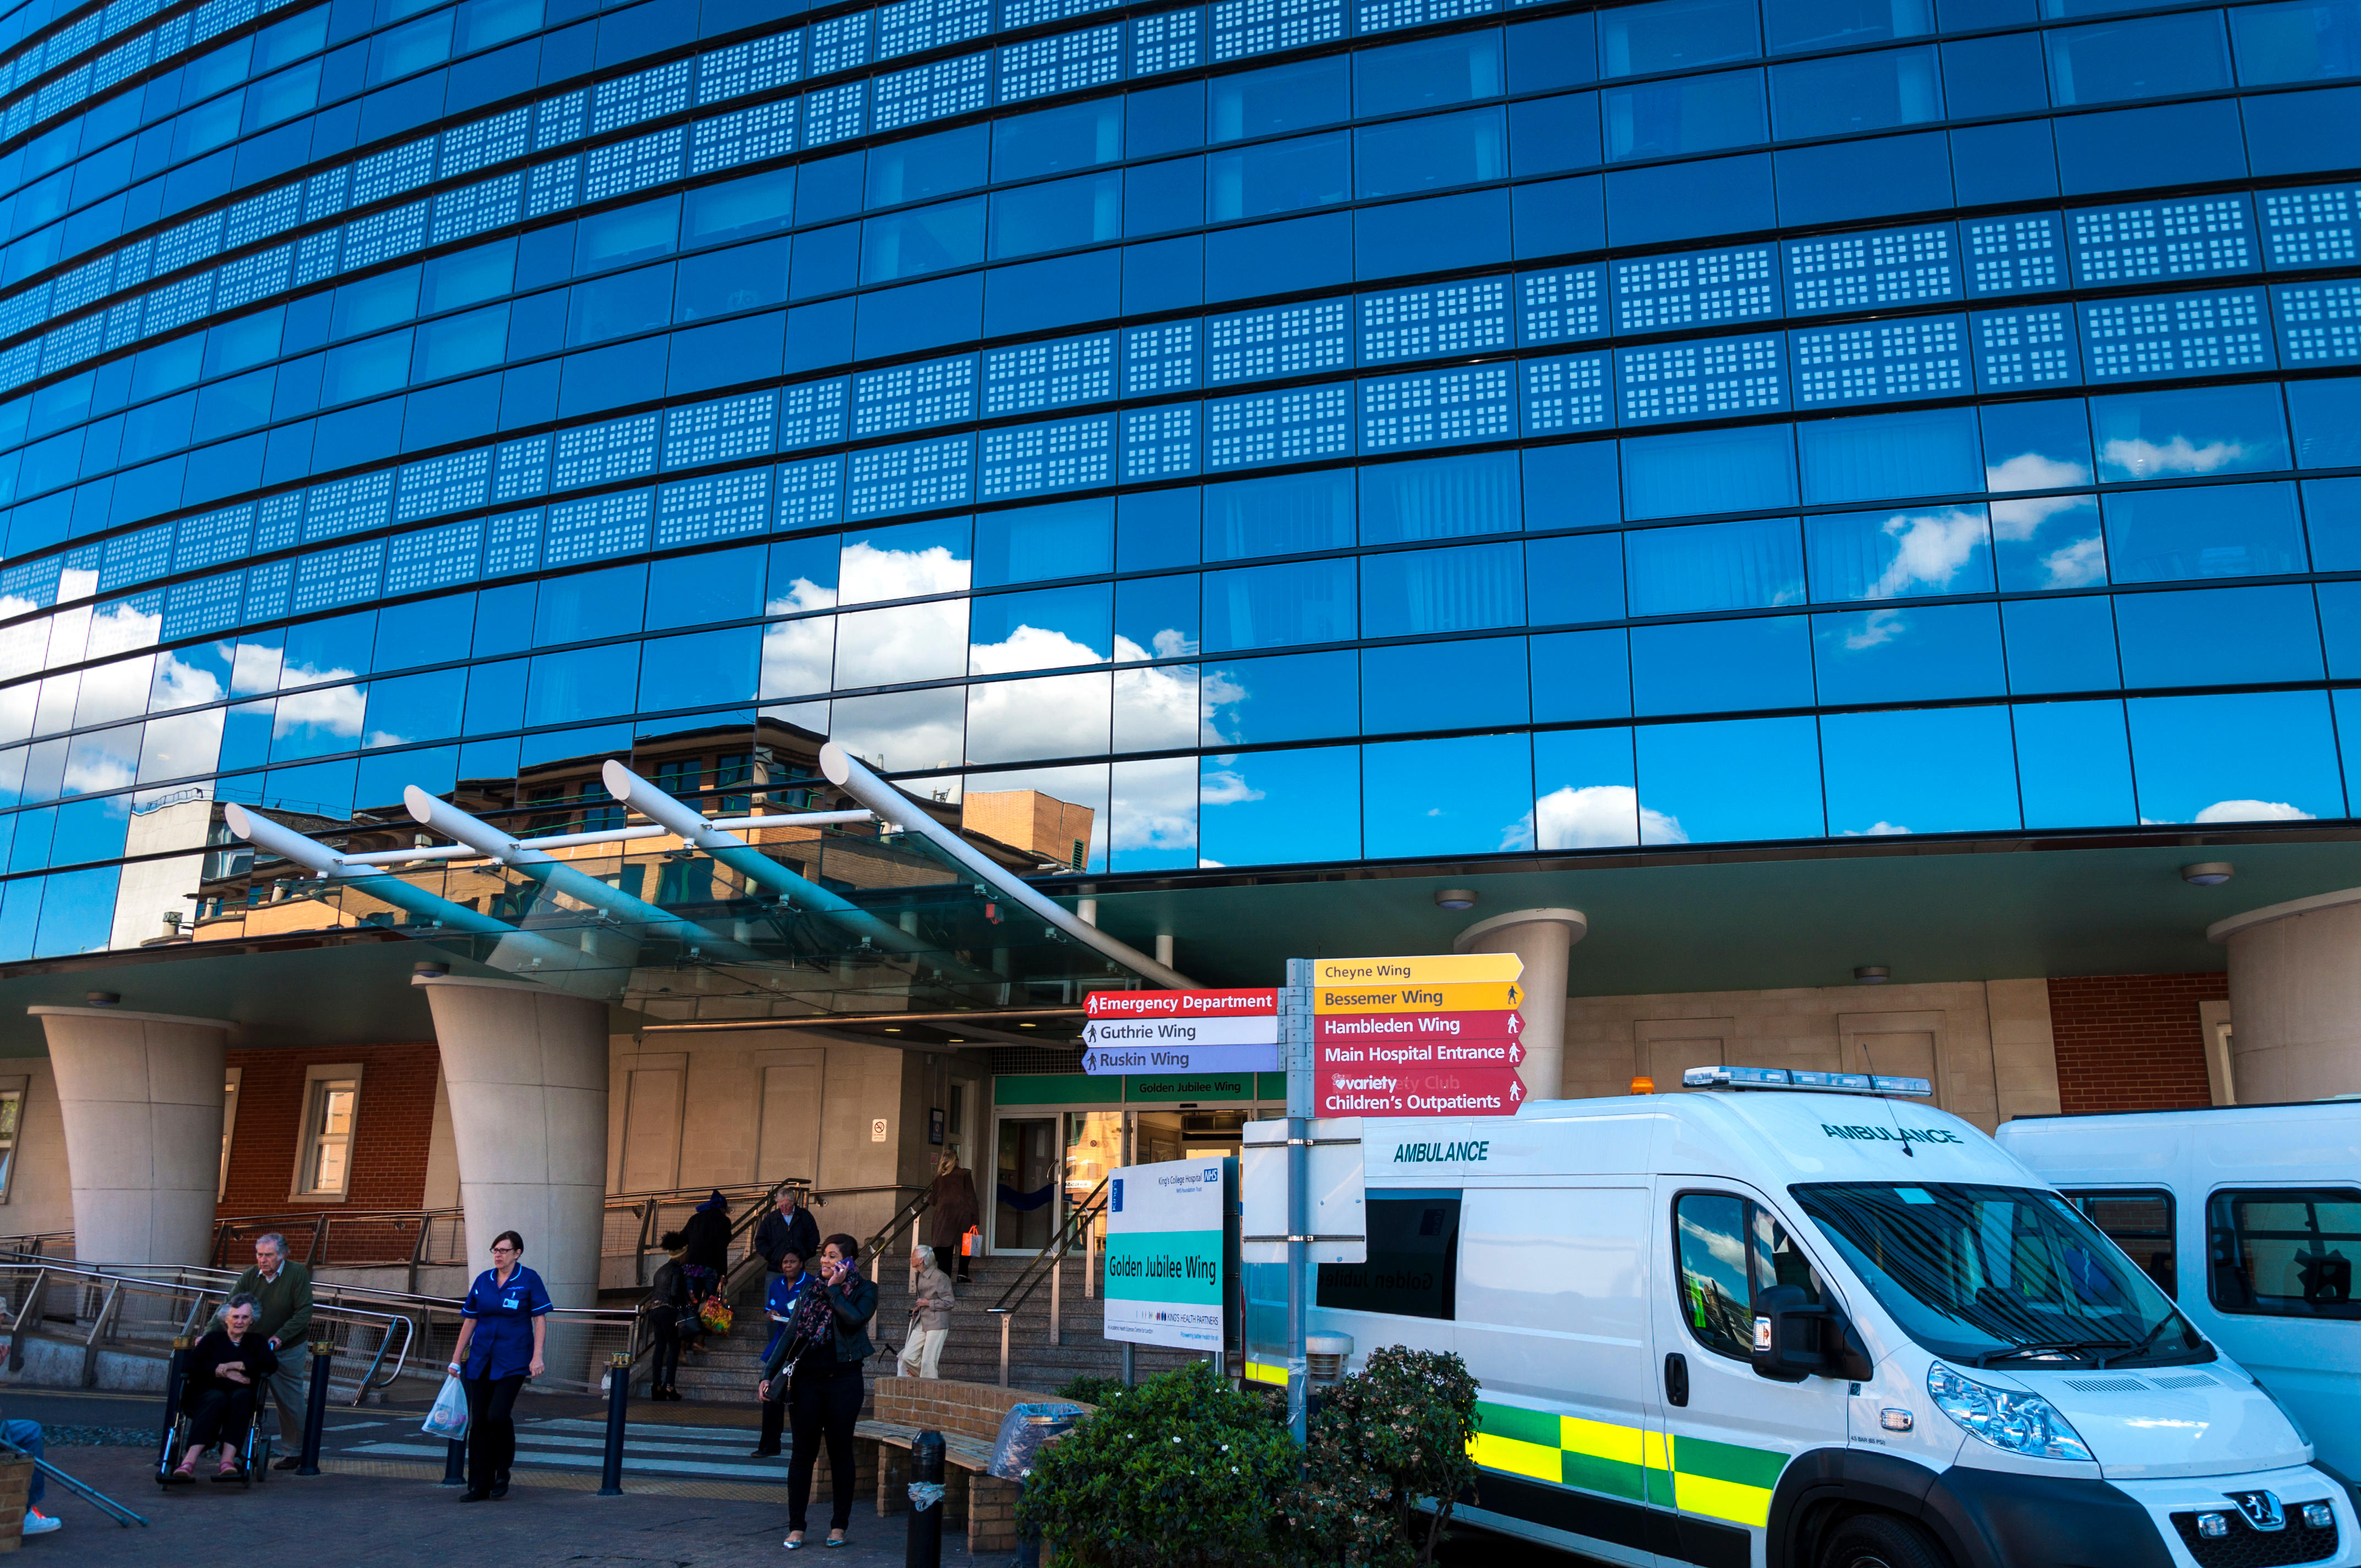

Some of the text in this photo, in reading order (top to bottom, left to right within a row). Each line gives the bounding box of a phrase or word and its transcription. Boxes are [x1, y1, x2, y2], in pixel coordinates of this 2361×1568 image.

[1325, 965, 1411, 980] Cheyne Wing
[1100, 995, 1272, 1012] Emergency Department
[1325, 989, 1443, 1006] Bessemer Wing
[1101, 1024, 1196, 1040] Guthrie Wing
[1325, 1017, 1460, 1035] Hambleden Wing
[1101, 1052, 1189, 1068] Ruskin Wing
[1325, 1045, 1505, 1064] Main Hospital Entrance
[1139, 1081, 1241, 1093] Golden Jubilee Wing
[1345, 1075, 1397, 1093] variety
[1325, 1093, 1502, 1113] Children's Outpatients
[1820, 1124, 1965, 1144] AMBULANCE
[1393, 1141, 1489, 1163] AMBULANCE
[1158, 1169, 1217, 1186] King's College Hospital NHS
[1109, 1254, 1216, 1286] Golden Jubilee Wing
[1167, 1313, 1218, 1326] KING'S HEALTH PARTNERS
